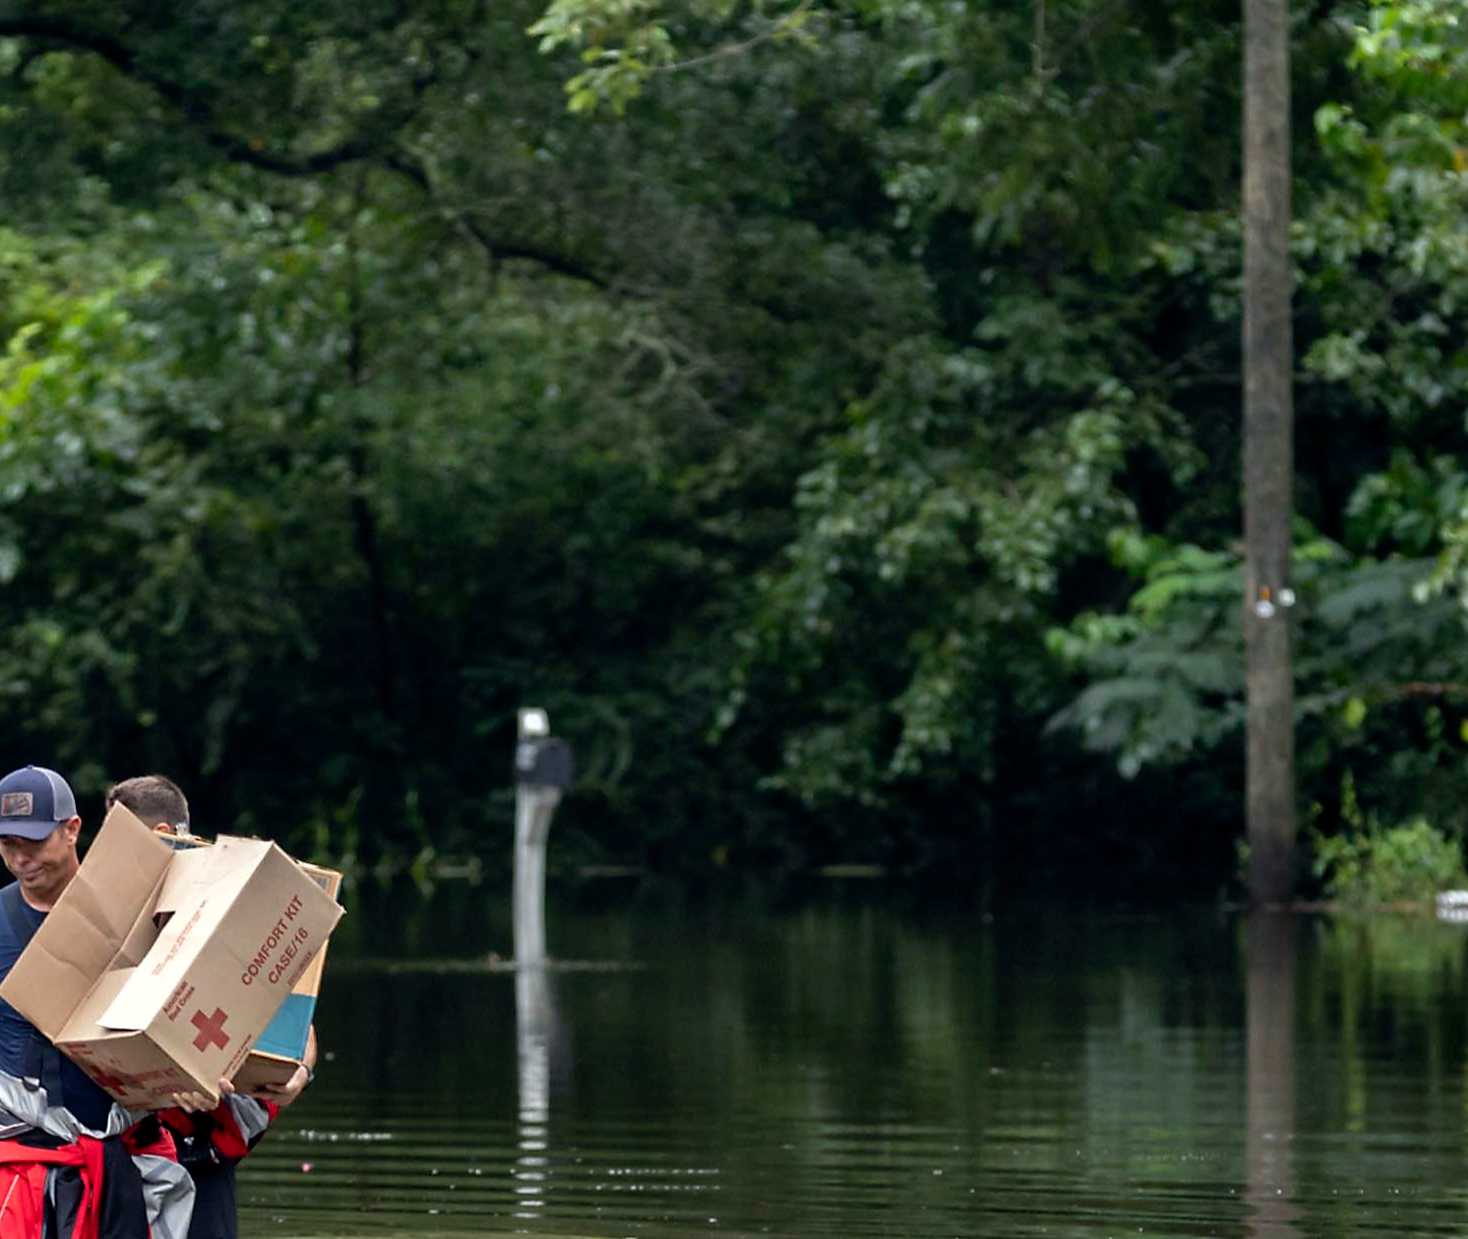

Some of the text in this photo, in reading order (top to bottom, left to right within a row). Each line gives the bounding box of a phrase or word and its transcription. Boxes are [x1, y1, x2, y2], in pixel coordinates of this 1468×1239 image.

[241, 918, 288, 985] COMFORT
[284, 894, 303, 920] KIT
[268, 927, 308, 984] CASE/16
